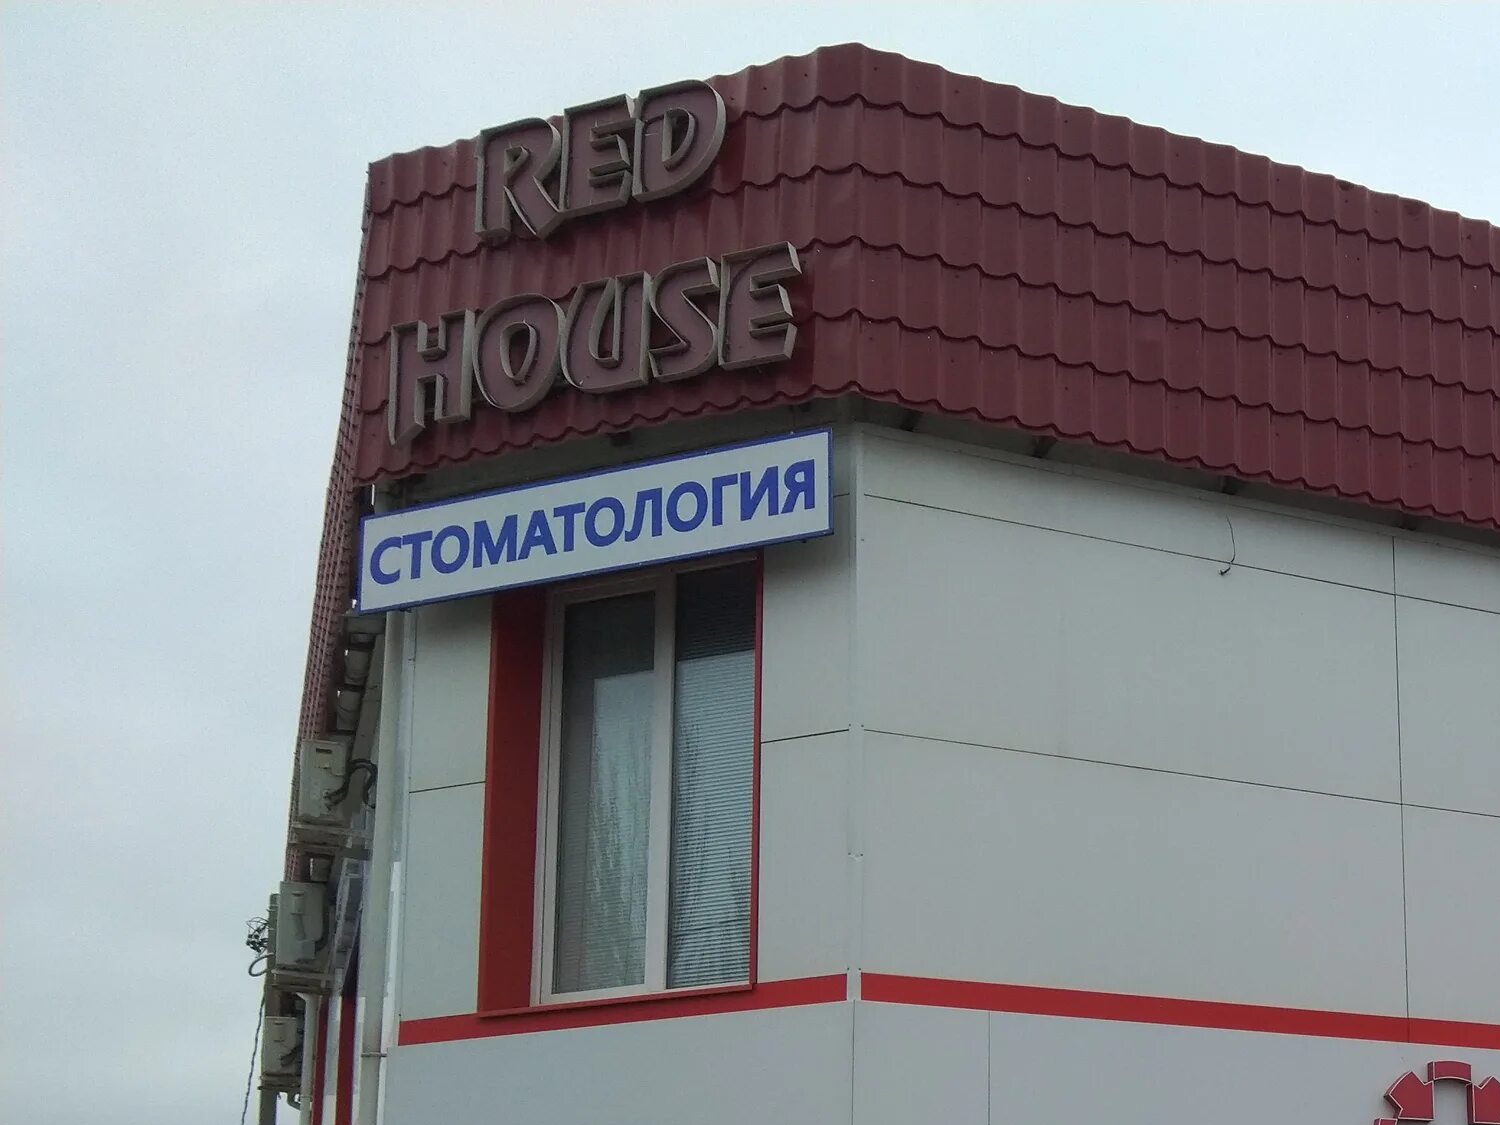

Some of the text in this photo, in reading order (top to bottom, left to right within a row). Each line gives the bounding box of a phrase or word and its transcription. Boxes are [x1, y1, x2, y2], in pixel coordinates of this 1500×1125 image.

[474, 80, 727, 240] RED
[388, 241, 803, 445] HOUSE
[369, 459, 816, 584] СТОМАТОЛОГИЯ
